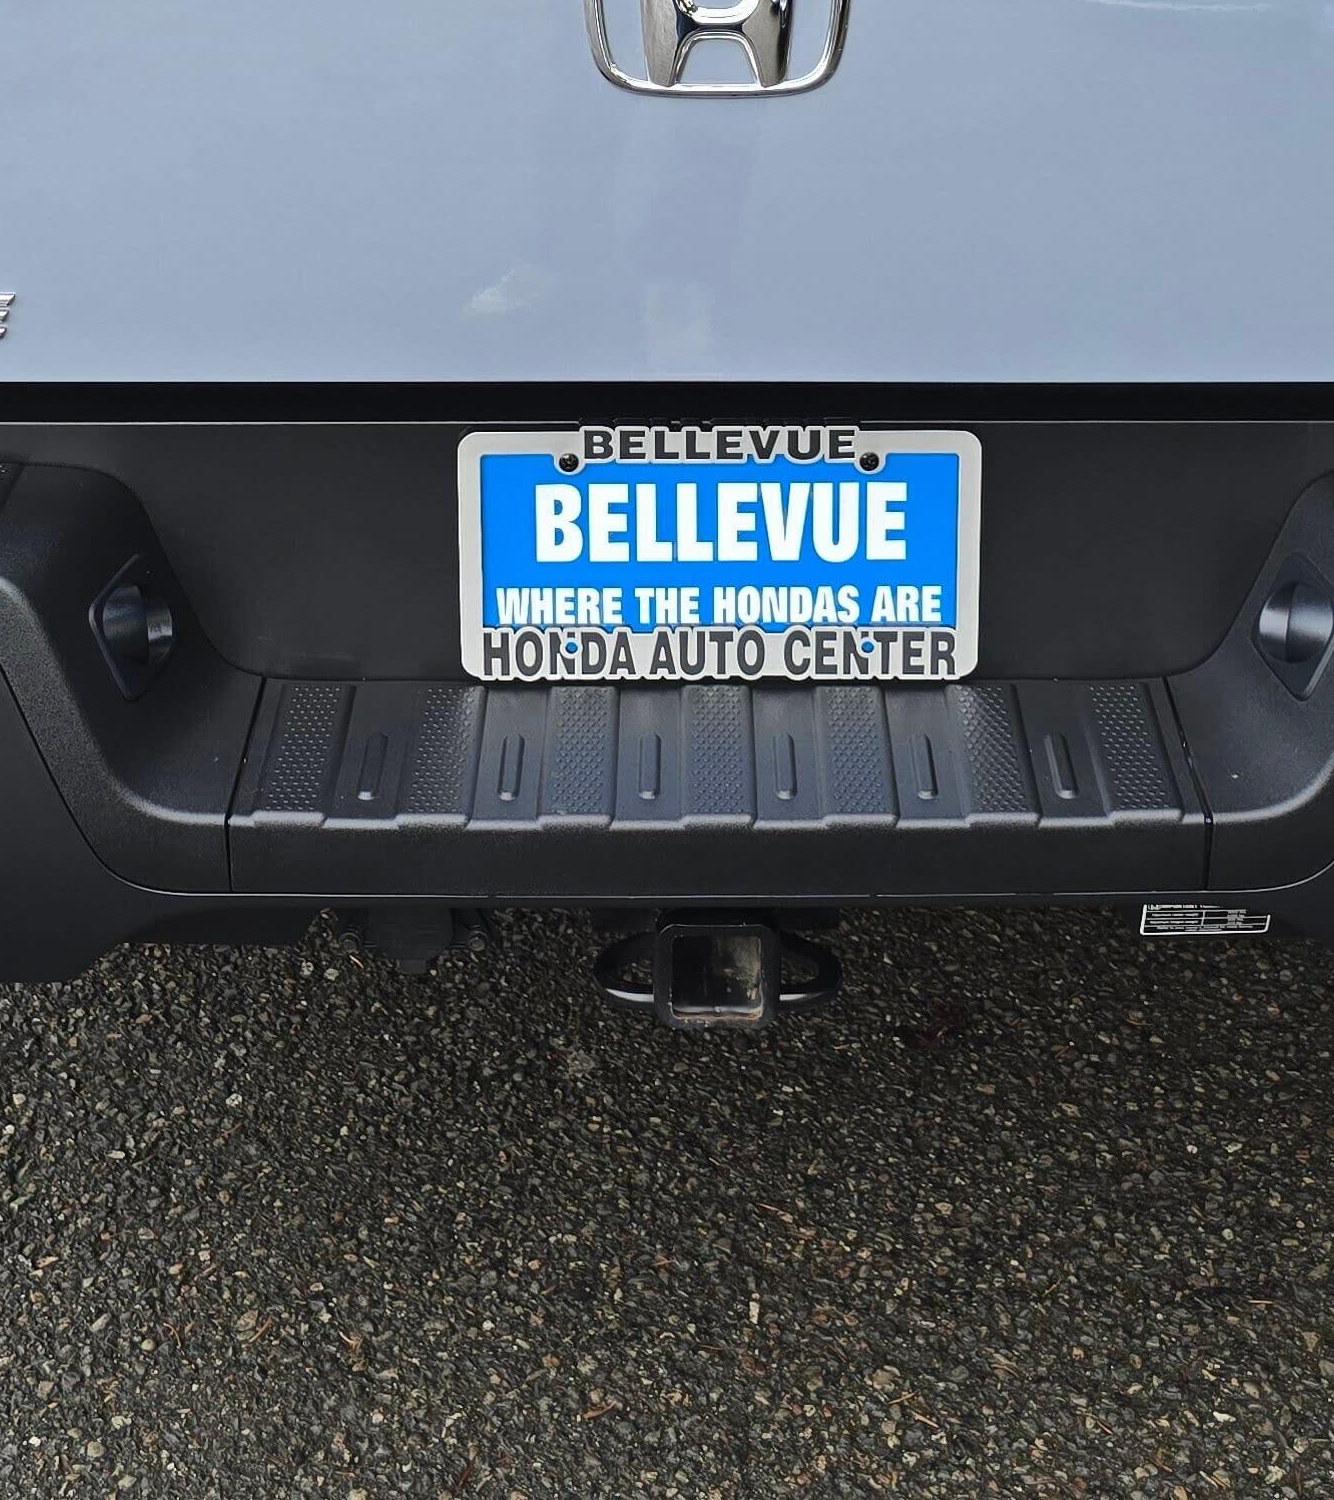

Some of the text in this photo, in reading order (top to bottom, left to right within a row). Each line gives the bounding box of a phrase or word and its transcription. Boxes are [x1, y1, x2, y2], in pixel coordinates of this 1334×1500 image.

[583, 428, 856, 461] BELLEVUE
[534, 481, 908, 563] BELLEVUE
[496, 584, 943, 625] WHERE THE HONDAS ARE
[482, 631, 957, 677] HONDA AUTO CENTER
